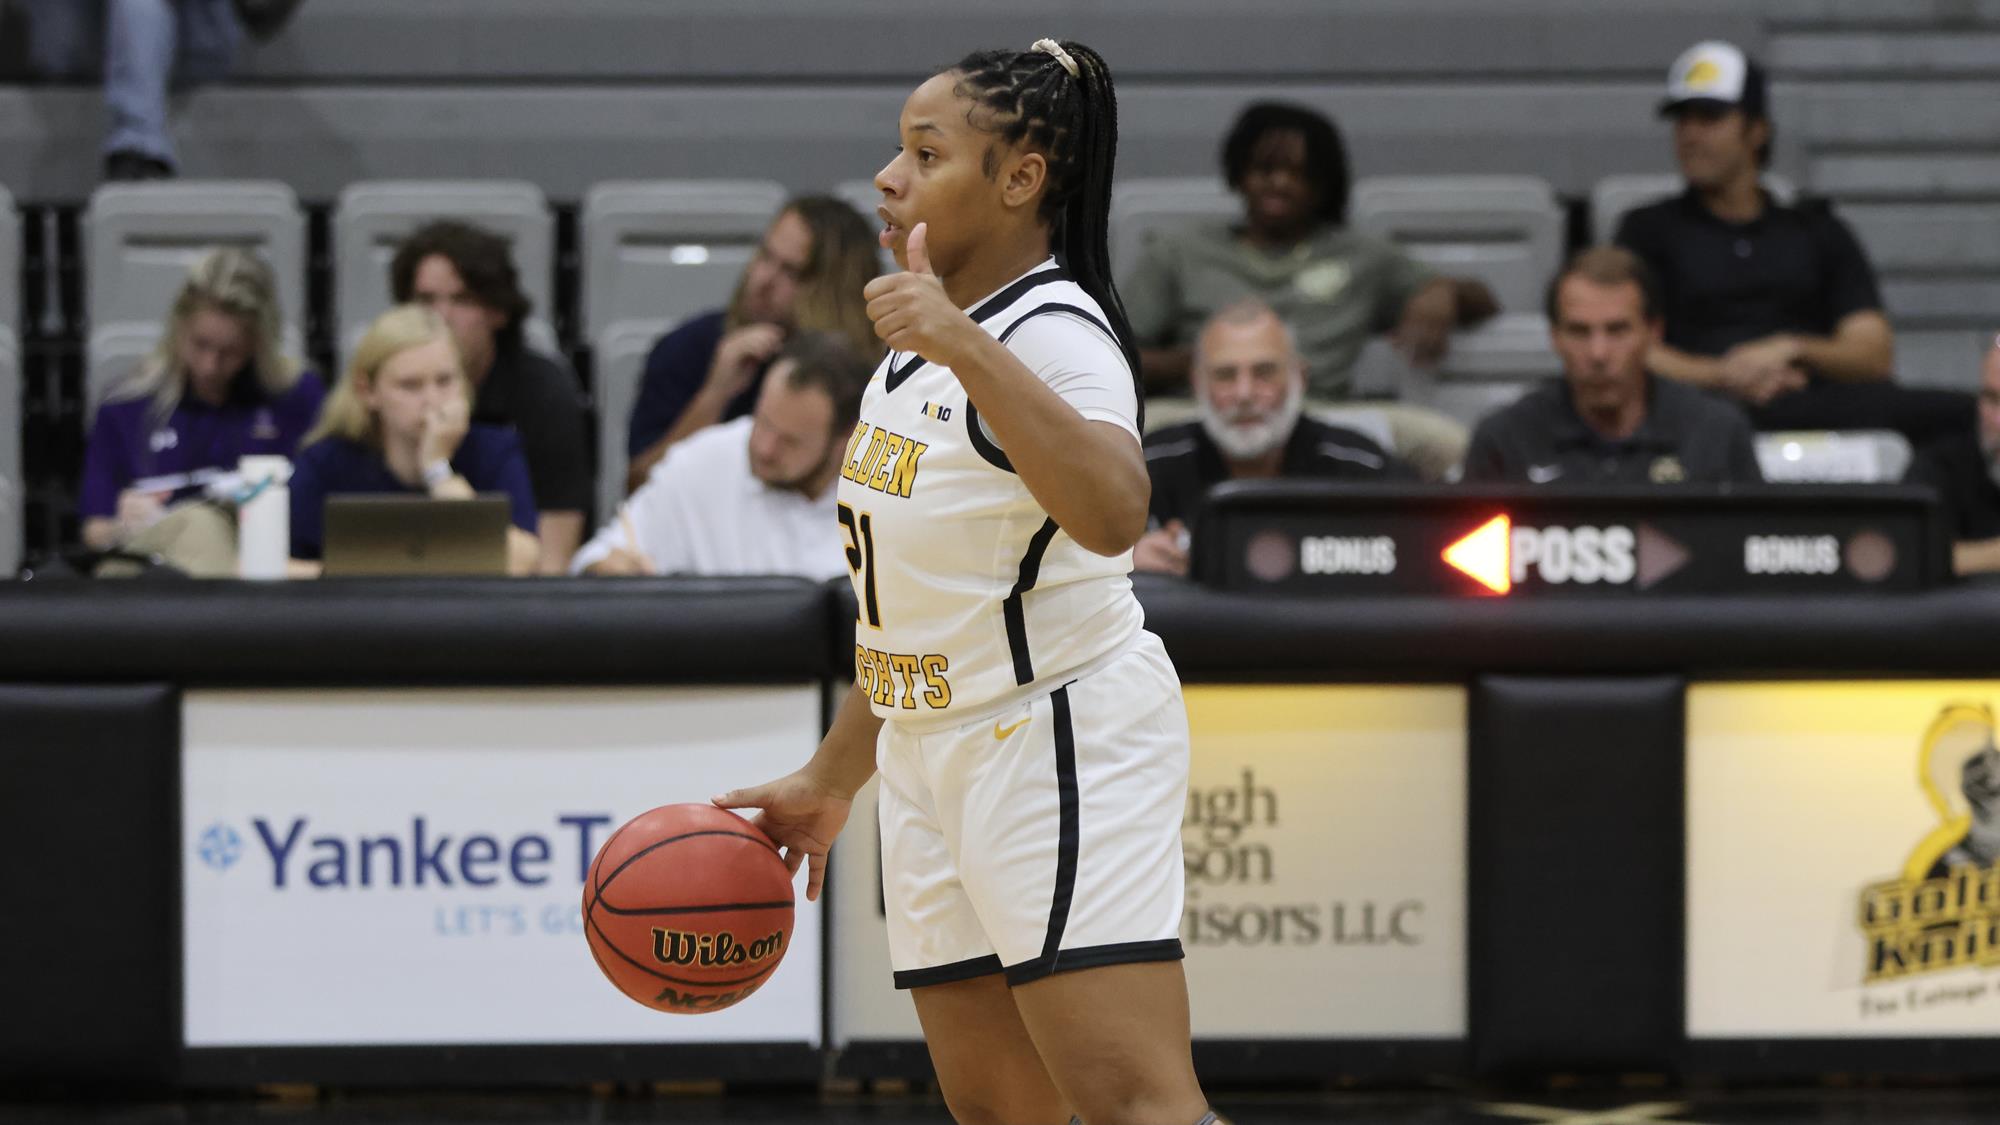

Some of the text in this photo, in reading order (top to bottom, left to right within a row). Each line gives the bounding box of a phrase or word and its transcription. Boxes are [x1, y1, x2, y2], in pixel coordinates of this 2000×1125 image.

[1301, 536, 1396, 574] BONUS
[1510, 525, 1635, 583] POSS
[1744, 535, 1840, 574] BONUS
[434, 904, 527, 935] LET'S
[1333, 900, 1423, 946] LLC
[651, 926, 783, 966] Wilson
